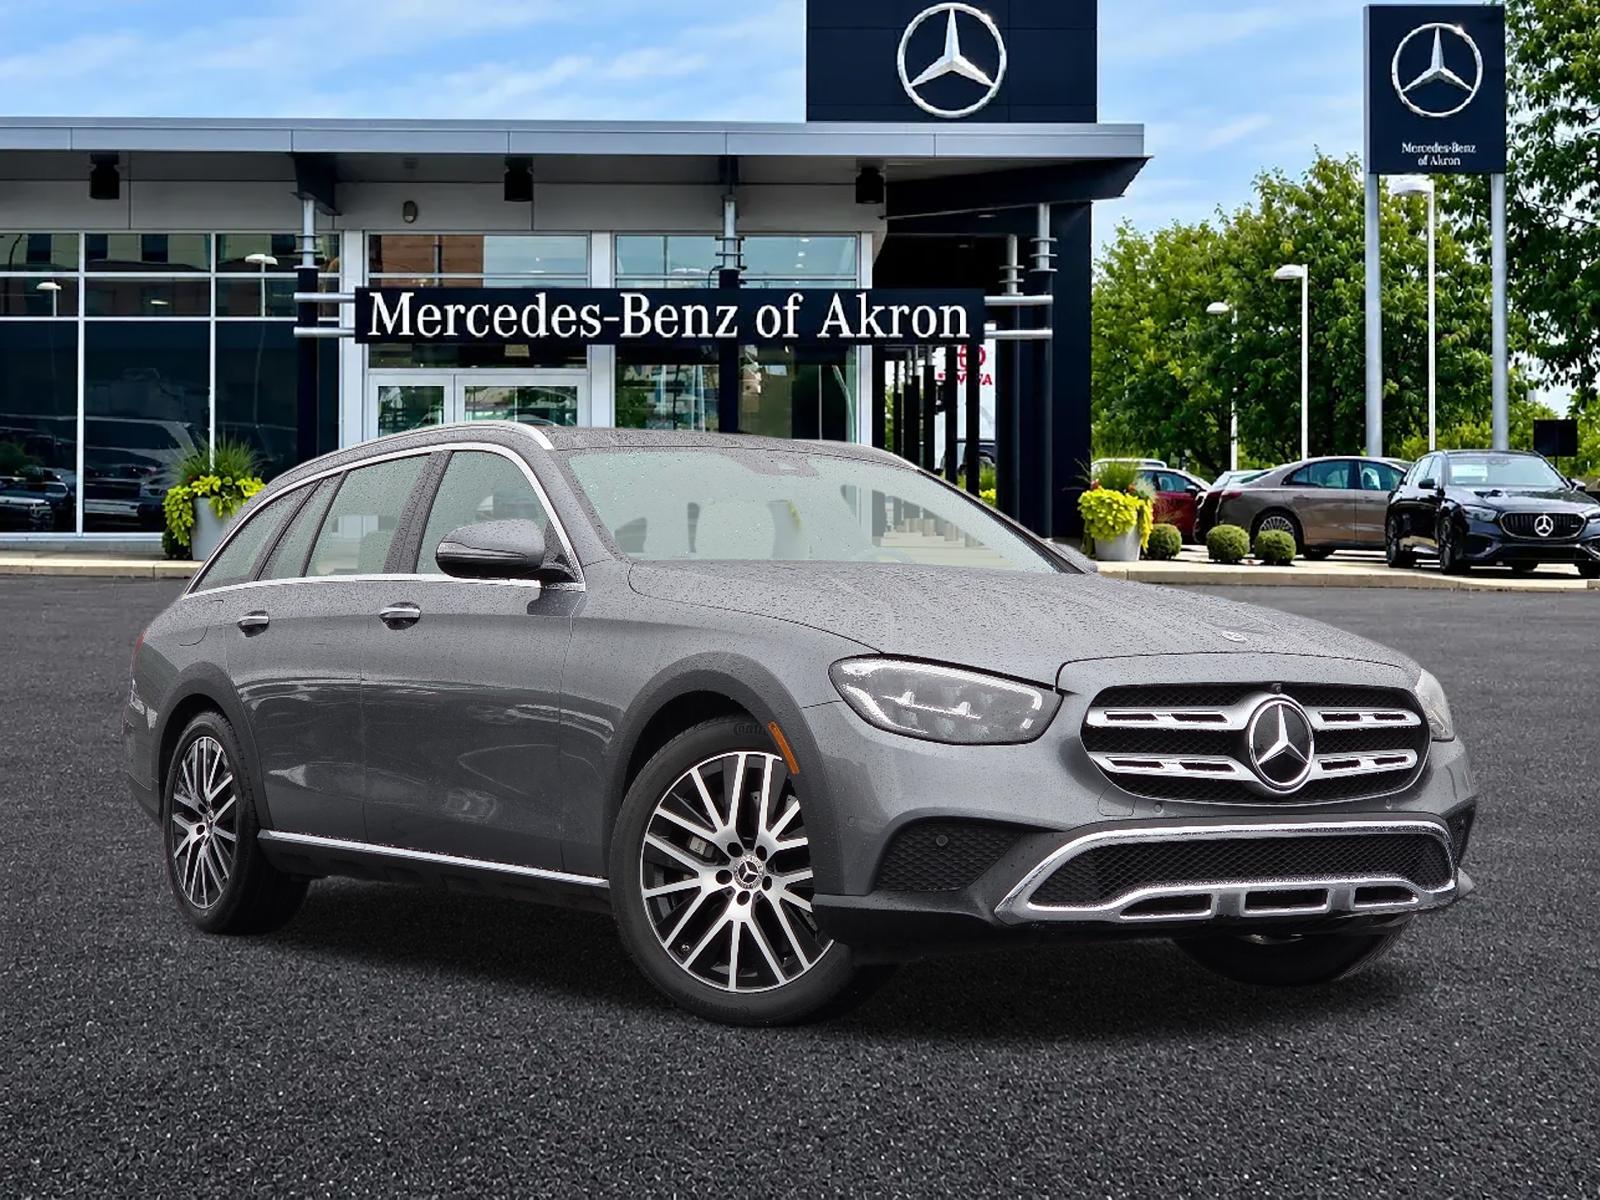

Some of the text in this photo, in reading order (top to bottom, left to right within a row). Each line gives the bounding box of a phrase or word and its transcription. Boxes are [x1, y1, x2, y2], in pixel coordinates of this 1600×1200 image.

[1401, 142, 1476, 153] Mercedes-Benz
[1417, 154, 1460, 166] of Akron
[367, 292, 970, 338] Mercedes-Benz of Akron
